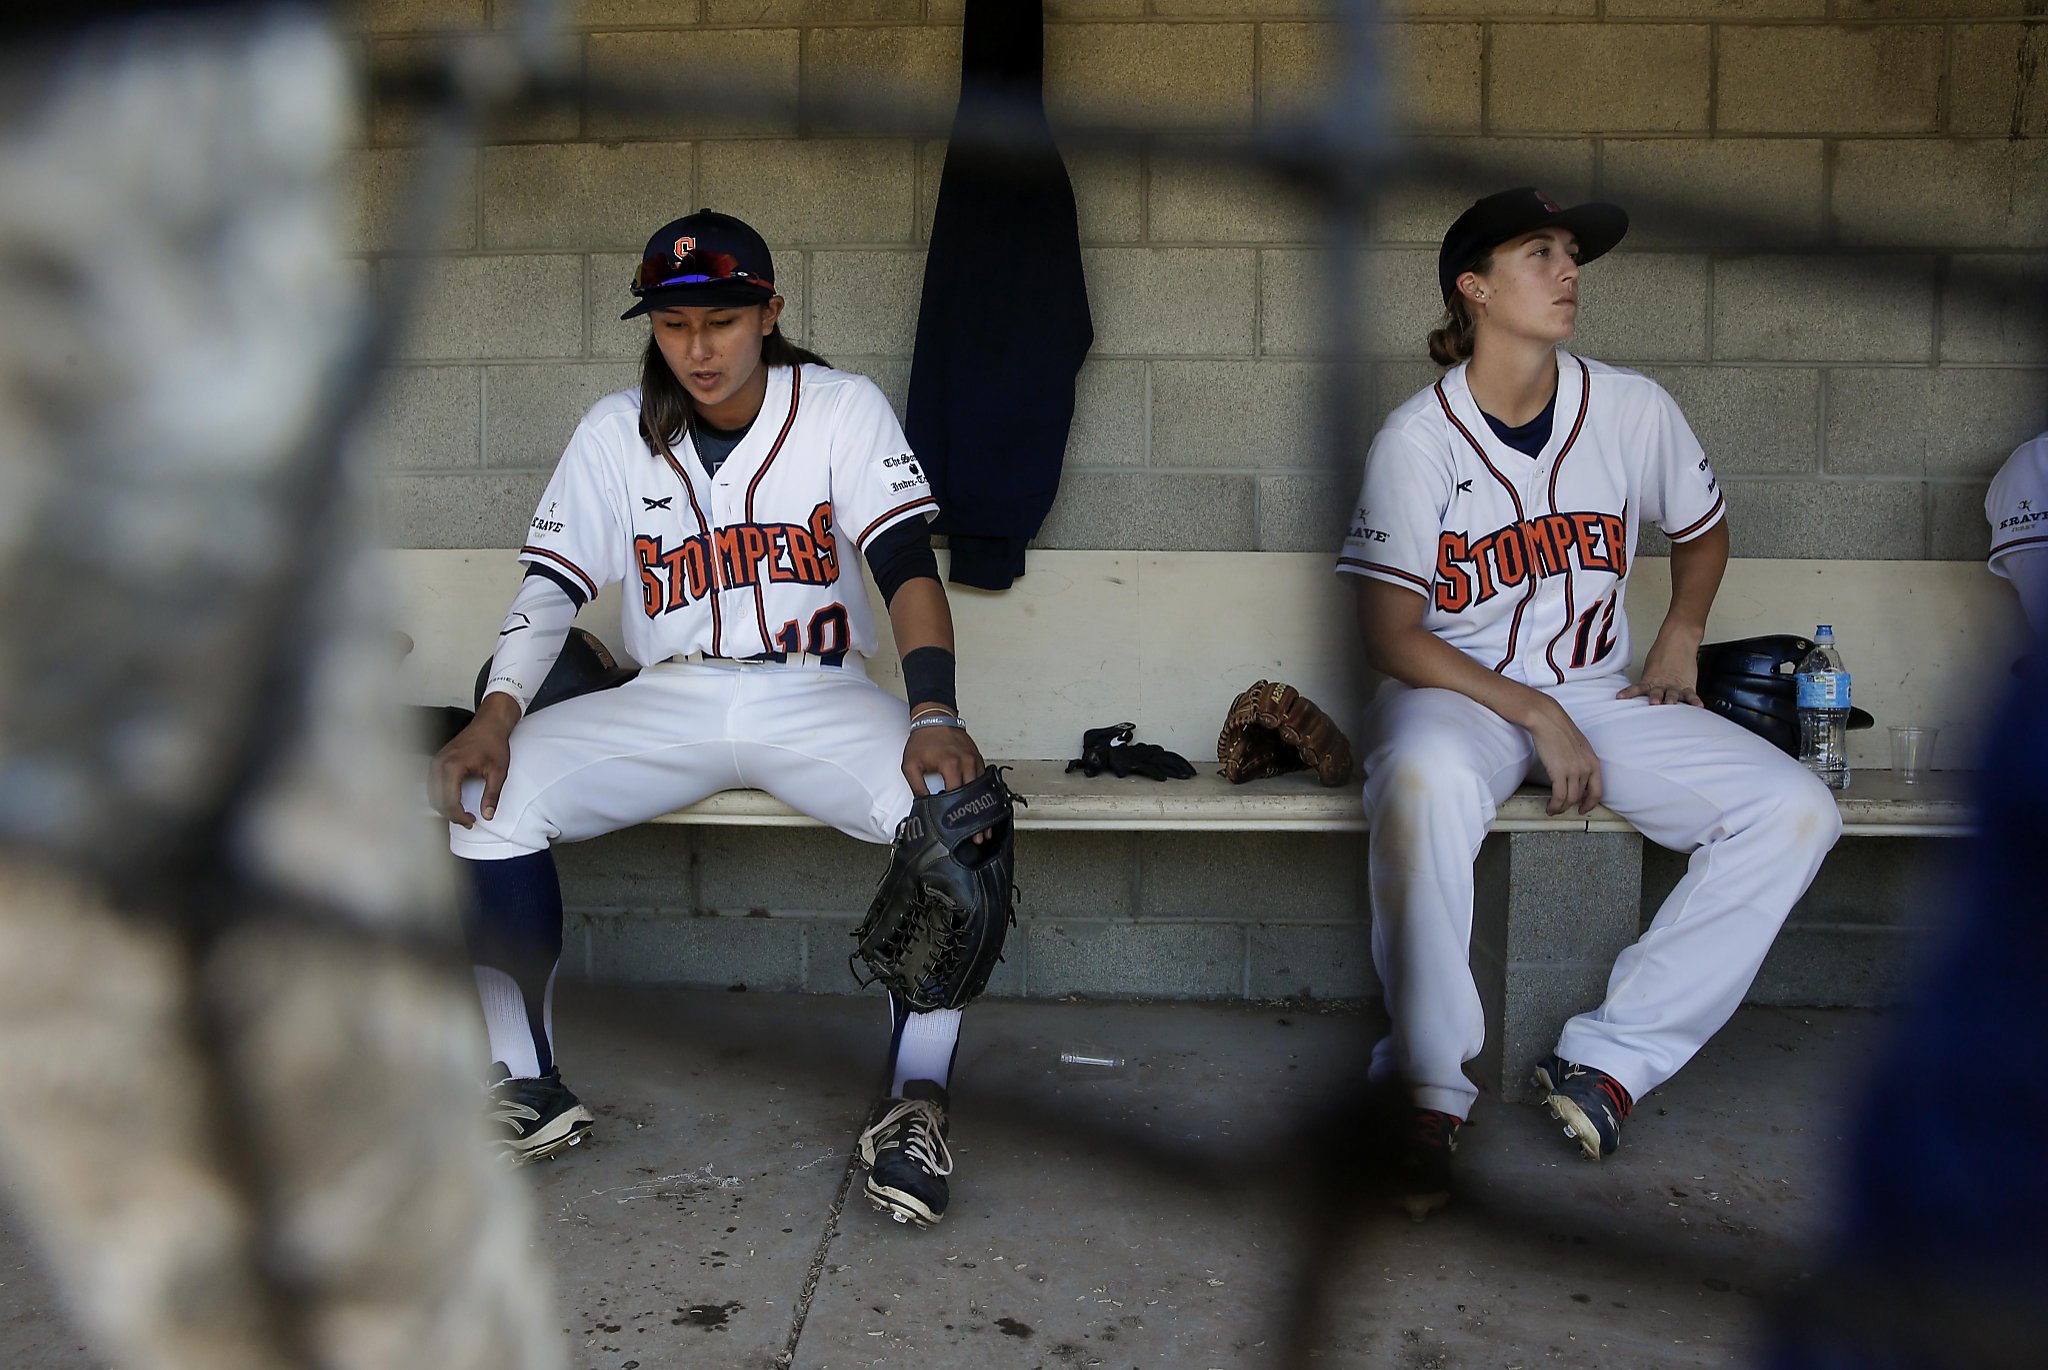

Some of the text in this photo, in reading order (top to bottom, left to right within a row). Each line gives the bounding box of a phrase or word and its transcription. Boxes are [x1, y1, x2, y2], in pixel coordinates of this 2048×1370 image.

[633, 500, 841, 621] STOMPERS
[775, 601, 850, 656] 10
[1568, 588, 1618, 668] 12
[944, 793, 997, 828] Wilson
